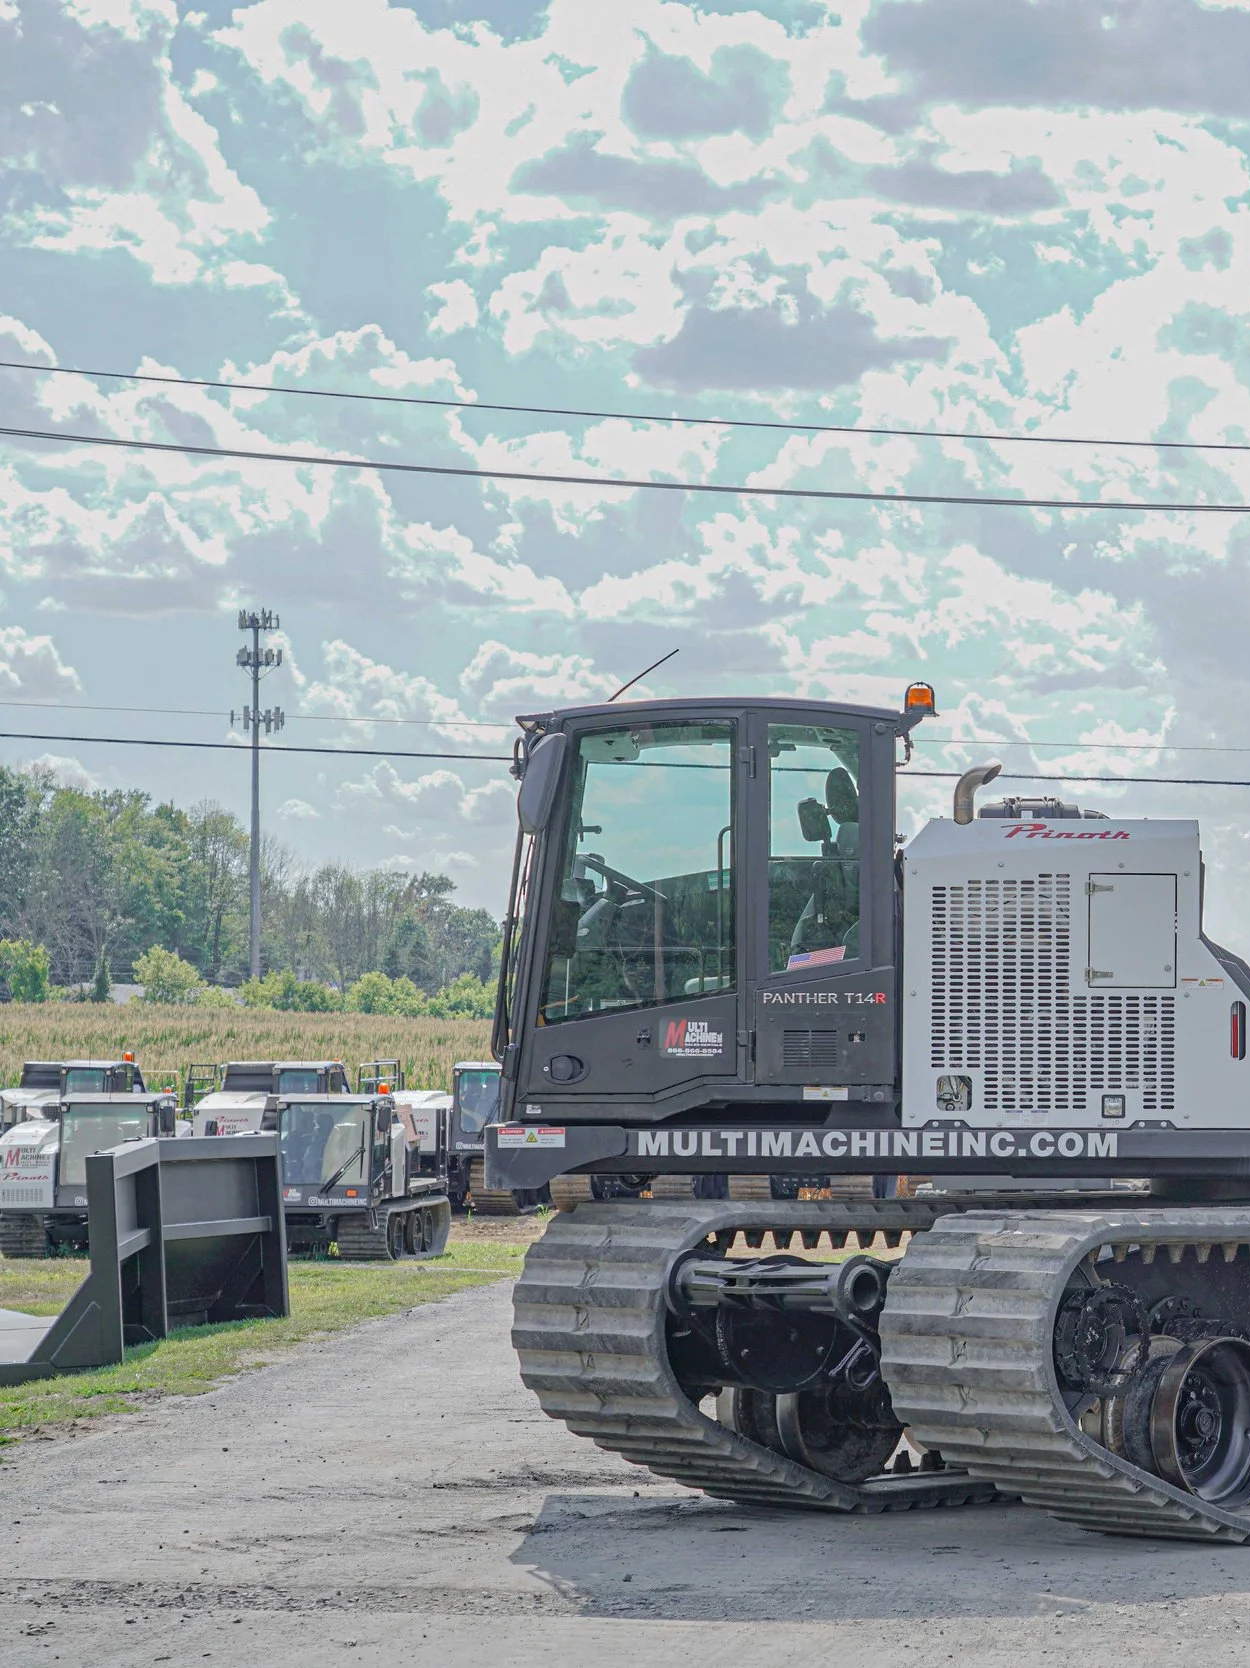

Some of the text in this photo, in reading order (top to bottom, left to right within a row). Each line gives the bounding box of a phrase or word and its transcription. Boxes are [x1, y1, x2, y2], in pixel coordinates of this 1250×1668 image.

[1000, 823, 1130, 840] Prinoth
[762, 992, 886, 1004] PANTHER T14R
[637, 1131, 1118, 1158] MULTIMACHINEINC.COM
[3, 1172, 48, 1181] Prinoth
[318, 1198, 367, 1206] MULTIMACHINEINC
